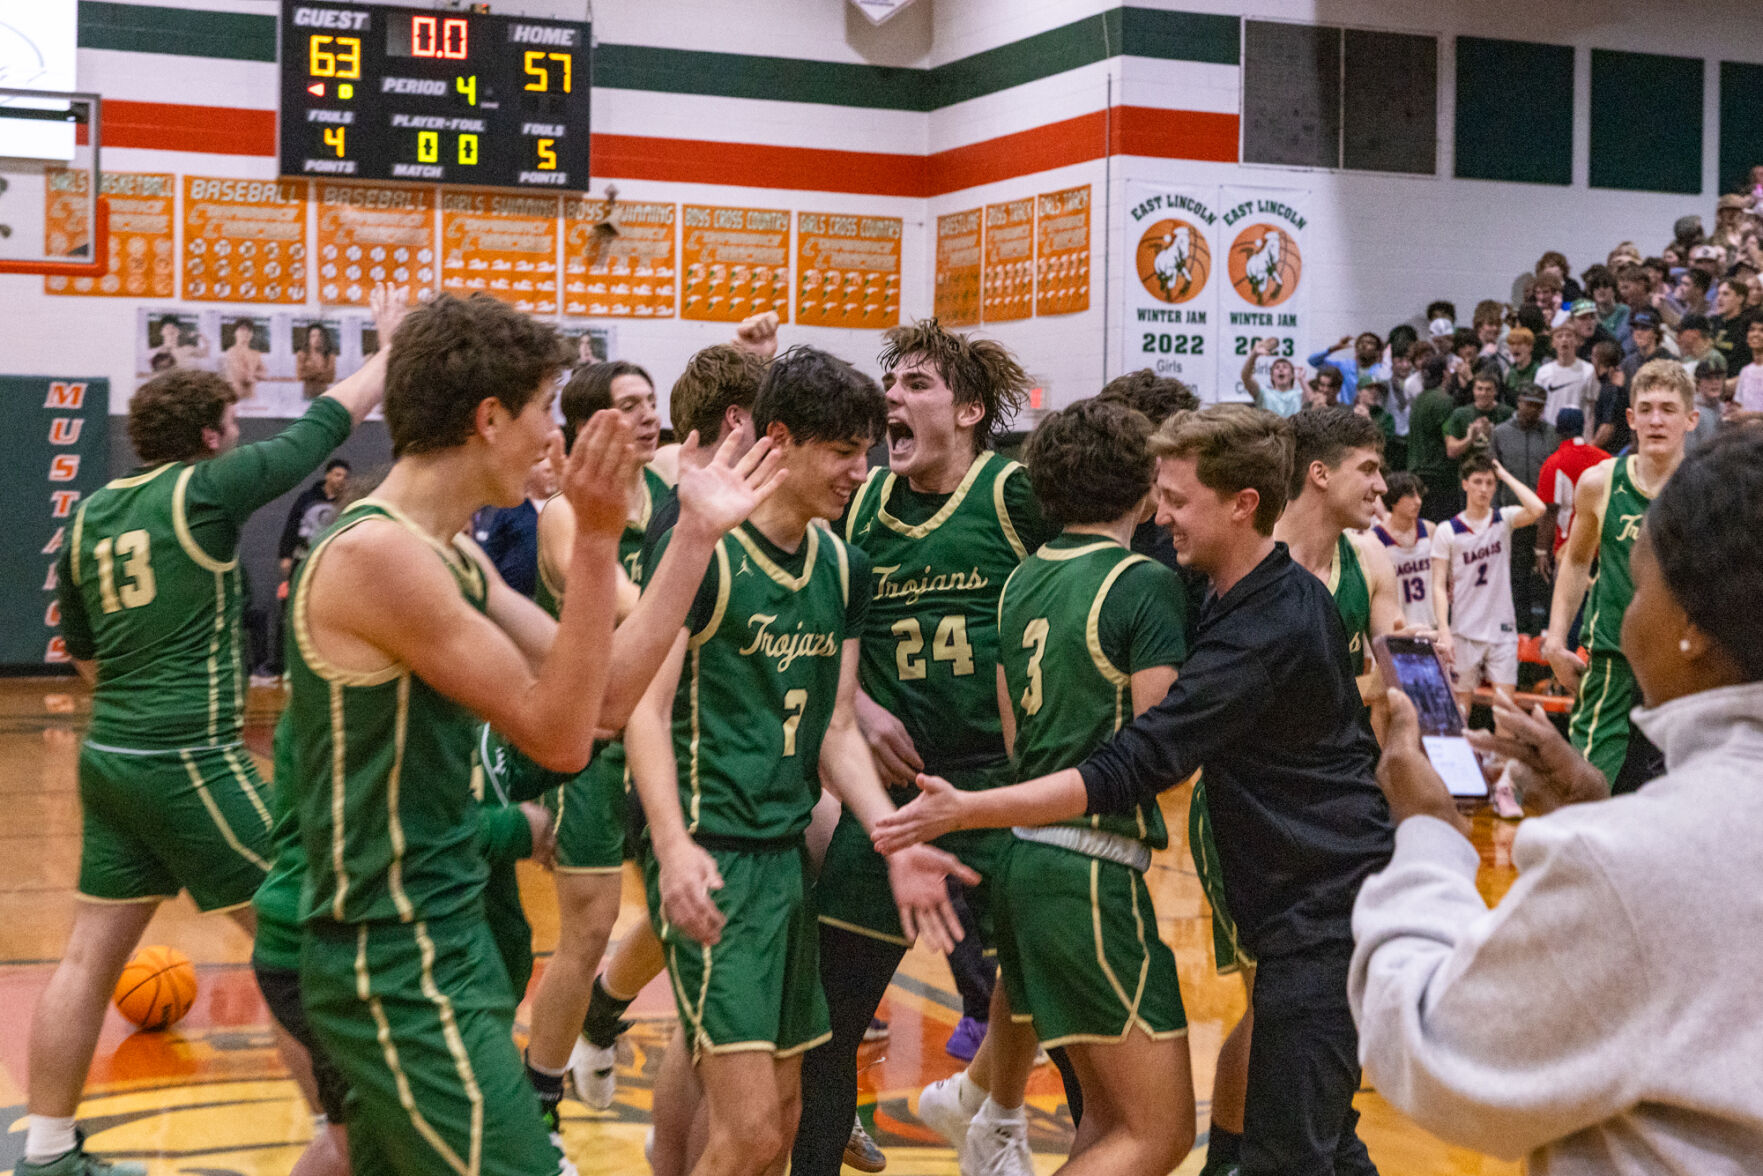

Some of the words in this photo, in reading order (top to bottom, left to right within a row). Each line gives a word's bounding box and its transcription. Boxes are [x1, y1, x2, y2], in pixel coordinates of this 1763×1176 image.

[294, 8, 369, 29] GUEST
[411, 16, 468, 60] 0.0
[513, 26, 574, 45] HOME
[310, 35, 361, 79] 63
[524, 51, 572, 94] 57
[382, 78, 447, 95] PERIOD
[456, 75, 476, 106] 4
[307, 110, 354, 124] FOULS
[392, 115, 485, 132] PLAYER-FOUL
[323, 127, 345, 158] 4
[522, 123, 565, 137] FOULS
[304, 160, 356, 173] POINTS
[537, 138, 557, 170] 5
[393, 164, 443, 178] MATCH
[520, 172, 567, 185] POINTS
[190, 179, 299, 205] BASEBALL
[324, 186, 427, 211] BASEBALL
[1130, 195, 1162, 222] EAST
[1167, 194, 1218, 226] LINCOLN
[1222, 201, 1253, 227] EAST
[1258, 200, 1307, 230] LINCOLN
[1137, 308, 1182, 323] WINTER
[1186, 311, 1207, 324] JAM
[1230, 312, 1273, 326] WINTER
[1277, 314, 1297, 327] JAM
[1142, 333, 1204, 355] 2022
[1157, 359, 1182, 373] Girls
[94, 528, 158, 615] 13
[1396, 558, 1431, 577] AGLES
[872, 563, 988, 606] Trojans
[1402, 576, 1426, 604] 13
[891, 614, 975, 681] 24
[1020, 617, 1050, 716] 3
